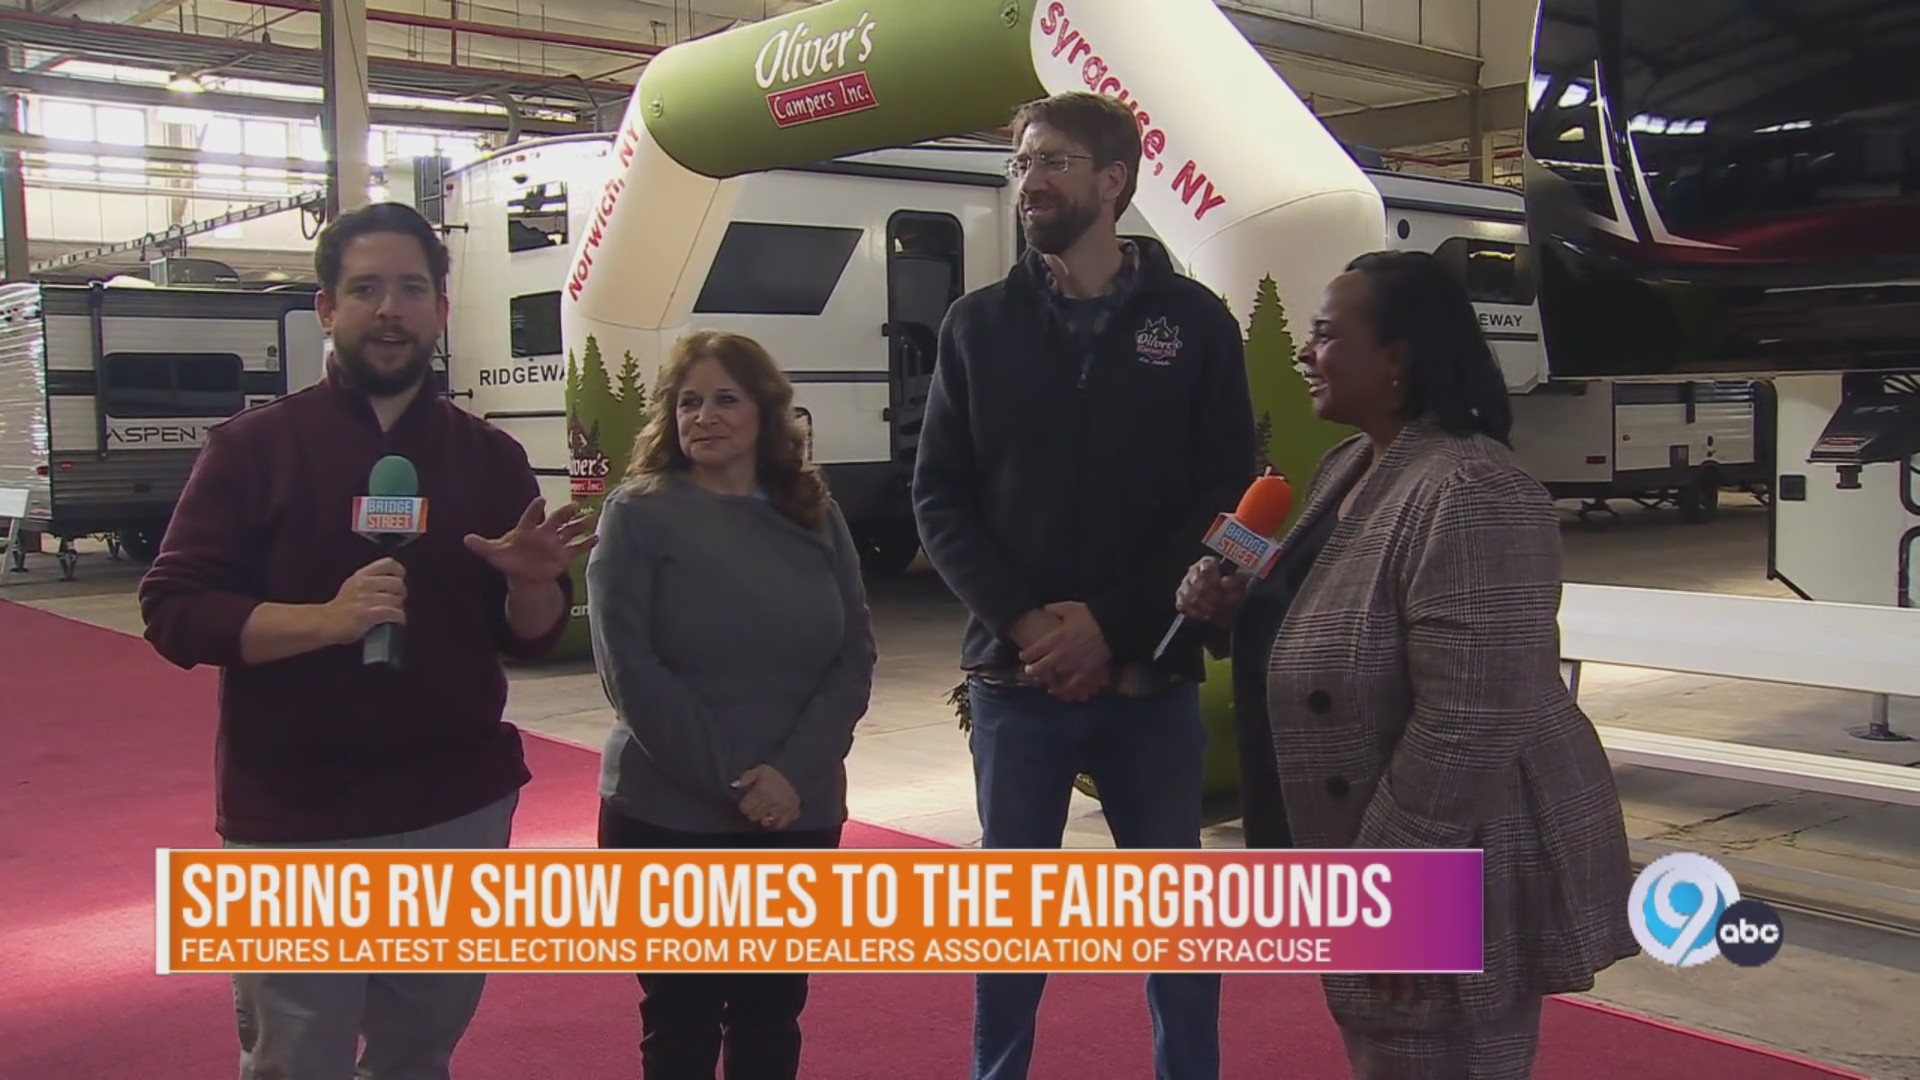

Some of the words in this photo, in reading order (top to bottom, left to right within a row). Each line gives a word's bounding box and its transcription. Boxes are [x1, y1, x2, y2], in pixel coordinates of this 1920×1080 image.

[755, 11, 876, 89] Oliver's
[773, 91, 836, 119] Campers
[839, 80, 870, 105] Inc.
[1171, 159, 1226, 221] NY
[568, 178, 626, 302] Norwich,
[619, 122, 639, 169] NY
[106, 426, 196, 443] ASPEN
[368, 500, 413, 513] BRIDGE
[368, 515, 411, 528] STREET
[1219, 537, 1259, 568] STREET
[1226, 524, 1268, 555] BRIDGE
